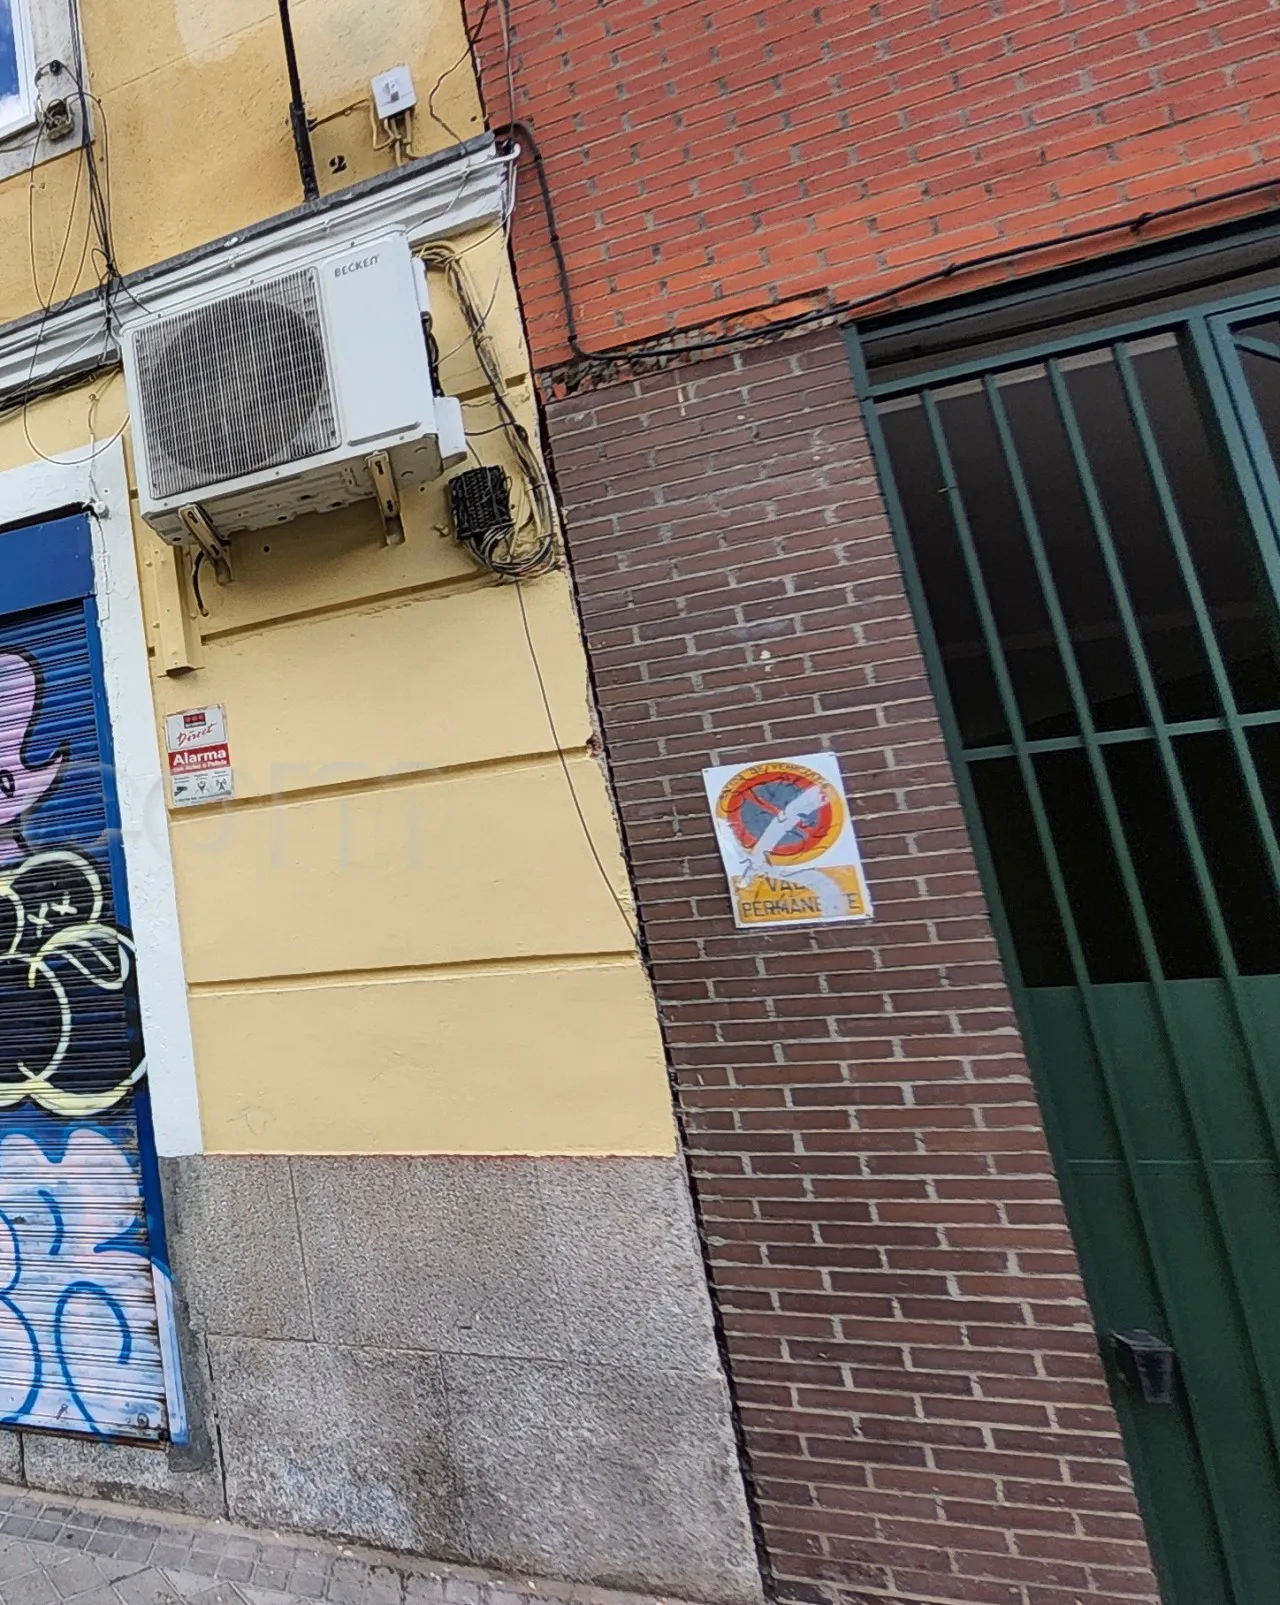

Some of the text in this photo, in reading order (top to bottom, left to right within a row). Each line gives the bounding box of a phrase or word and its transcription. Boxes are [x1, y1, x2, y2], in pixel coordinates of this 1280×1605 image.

[329, 155, 347, 174] 2
[177, 723, 216, 746] Direct
[173, 750, 226, 766] Alarma
